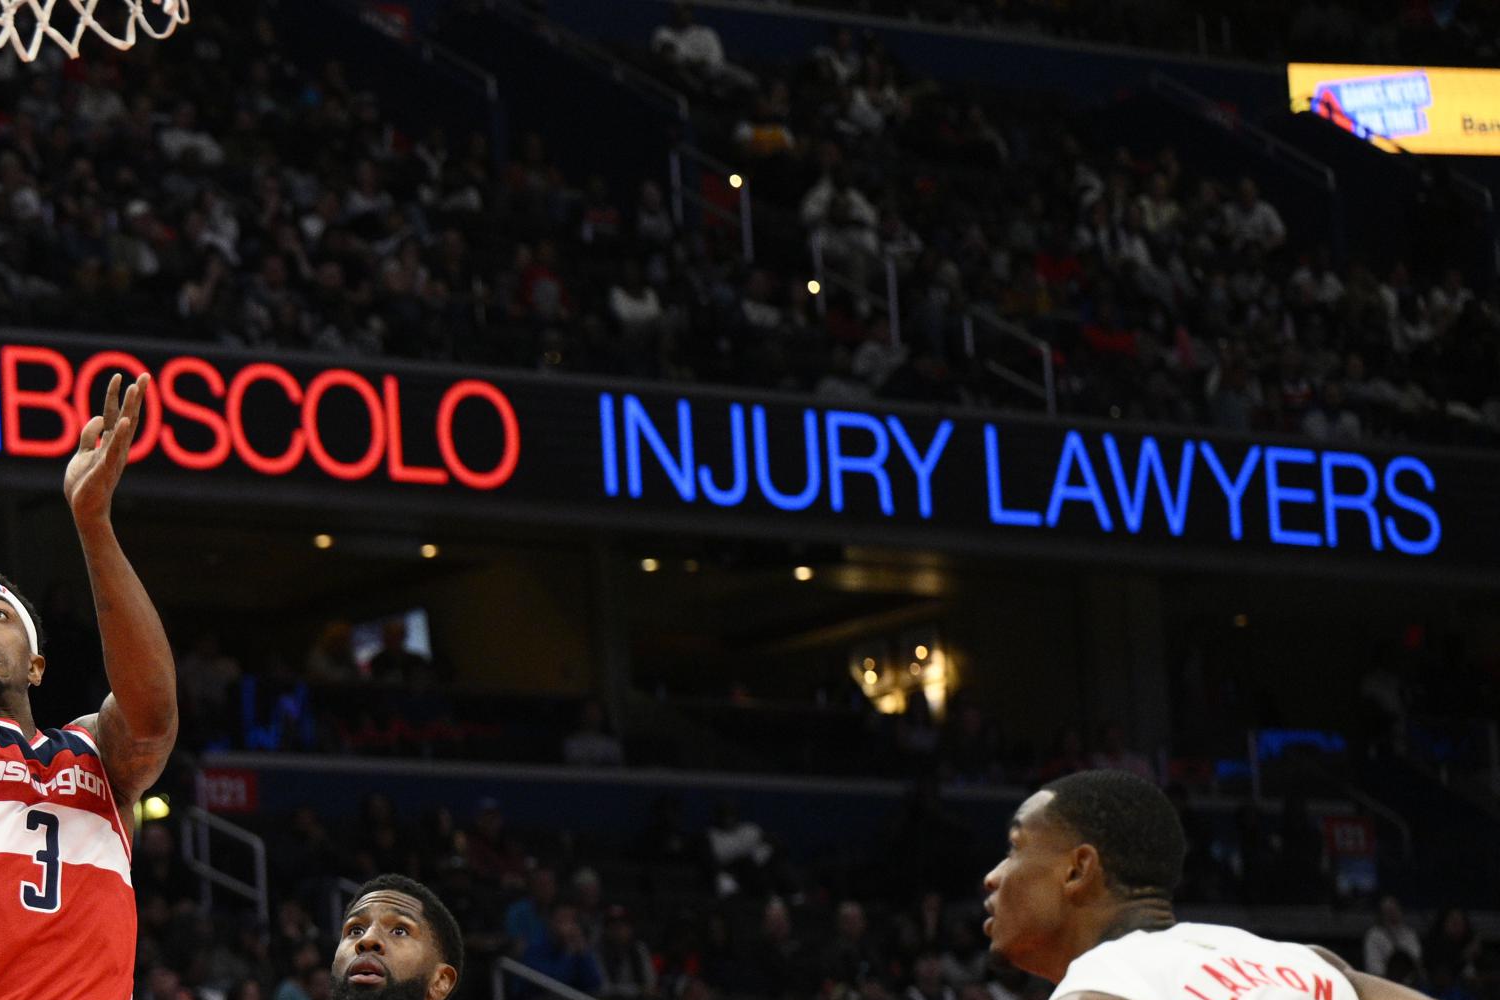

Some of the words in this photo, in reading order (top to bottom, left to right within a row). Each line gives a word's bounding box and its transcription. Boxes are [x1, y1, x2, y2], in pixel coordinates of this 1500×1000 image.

[599, 392, 954, 519] INJURY
[983, 423, 1442, 556] LAWYERS
[20, 809, 62, 913] 3
